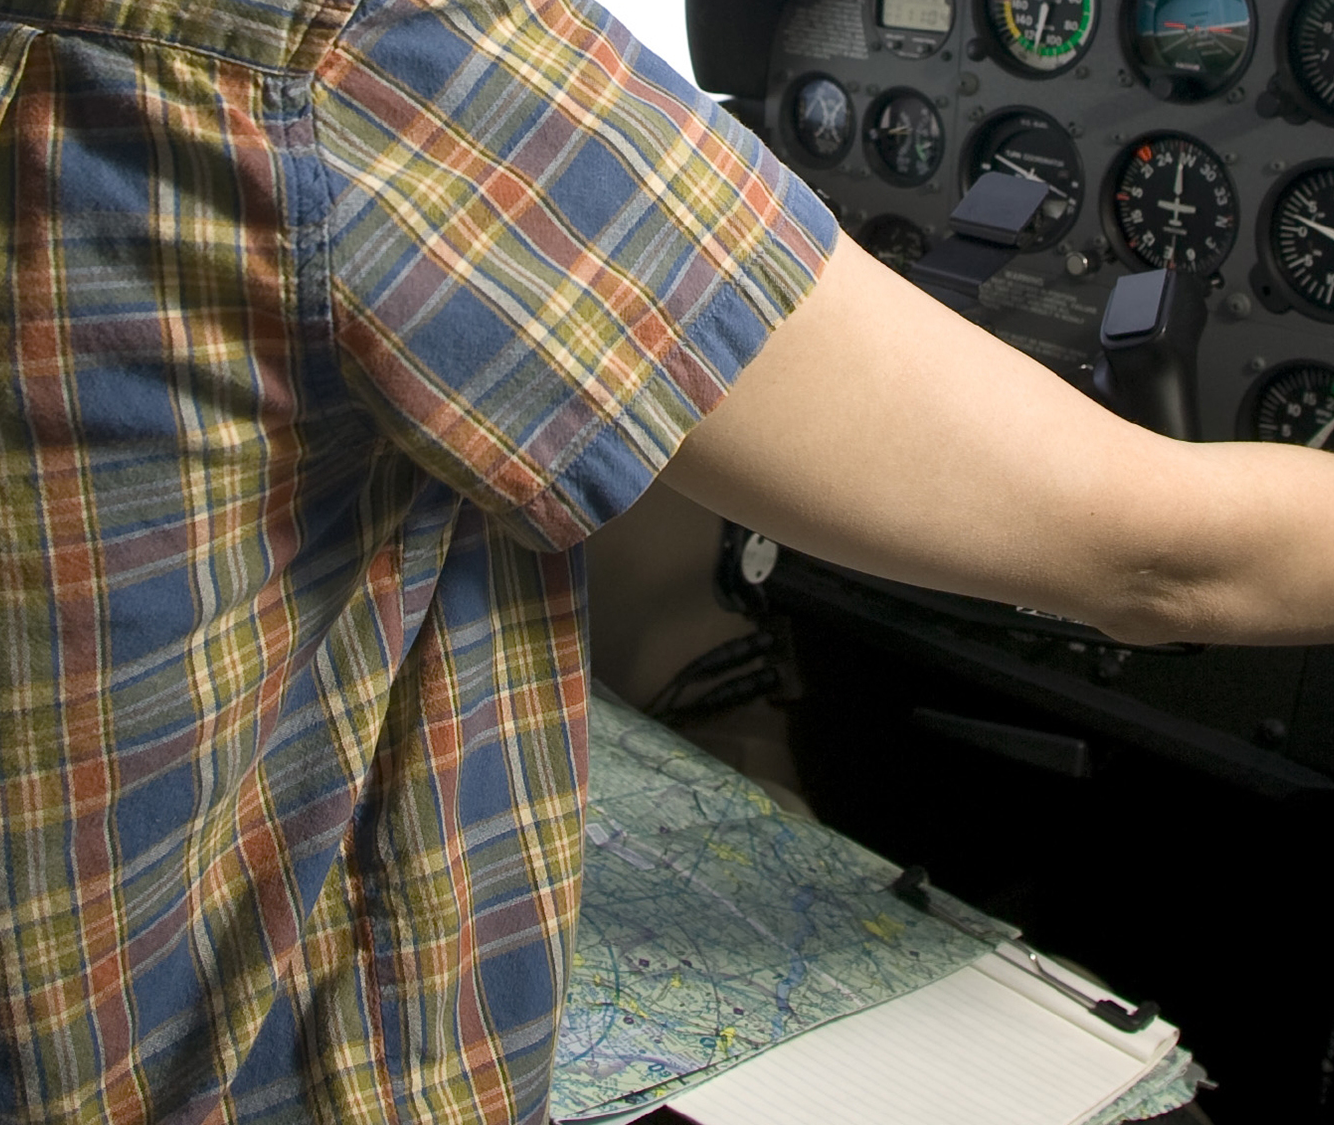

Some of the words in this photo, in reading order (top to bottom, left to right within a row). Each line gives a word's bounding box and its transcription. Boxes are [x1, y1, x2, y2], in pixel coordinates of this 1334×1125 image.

[1156, 151, 1173, 167] 24
[1199, 163, 1217, 182] 30
[1287, 402, 1302, 417] 10
